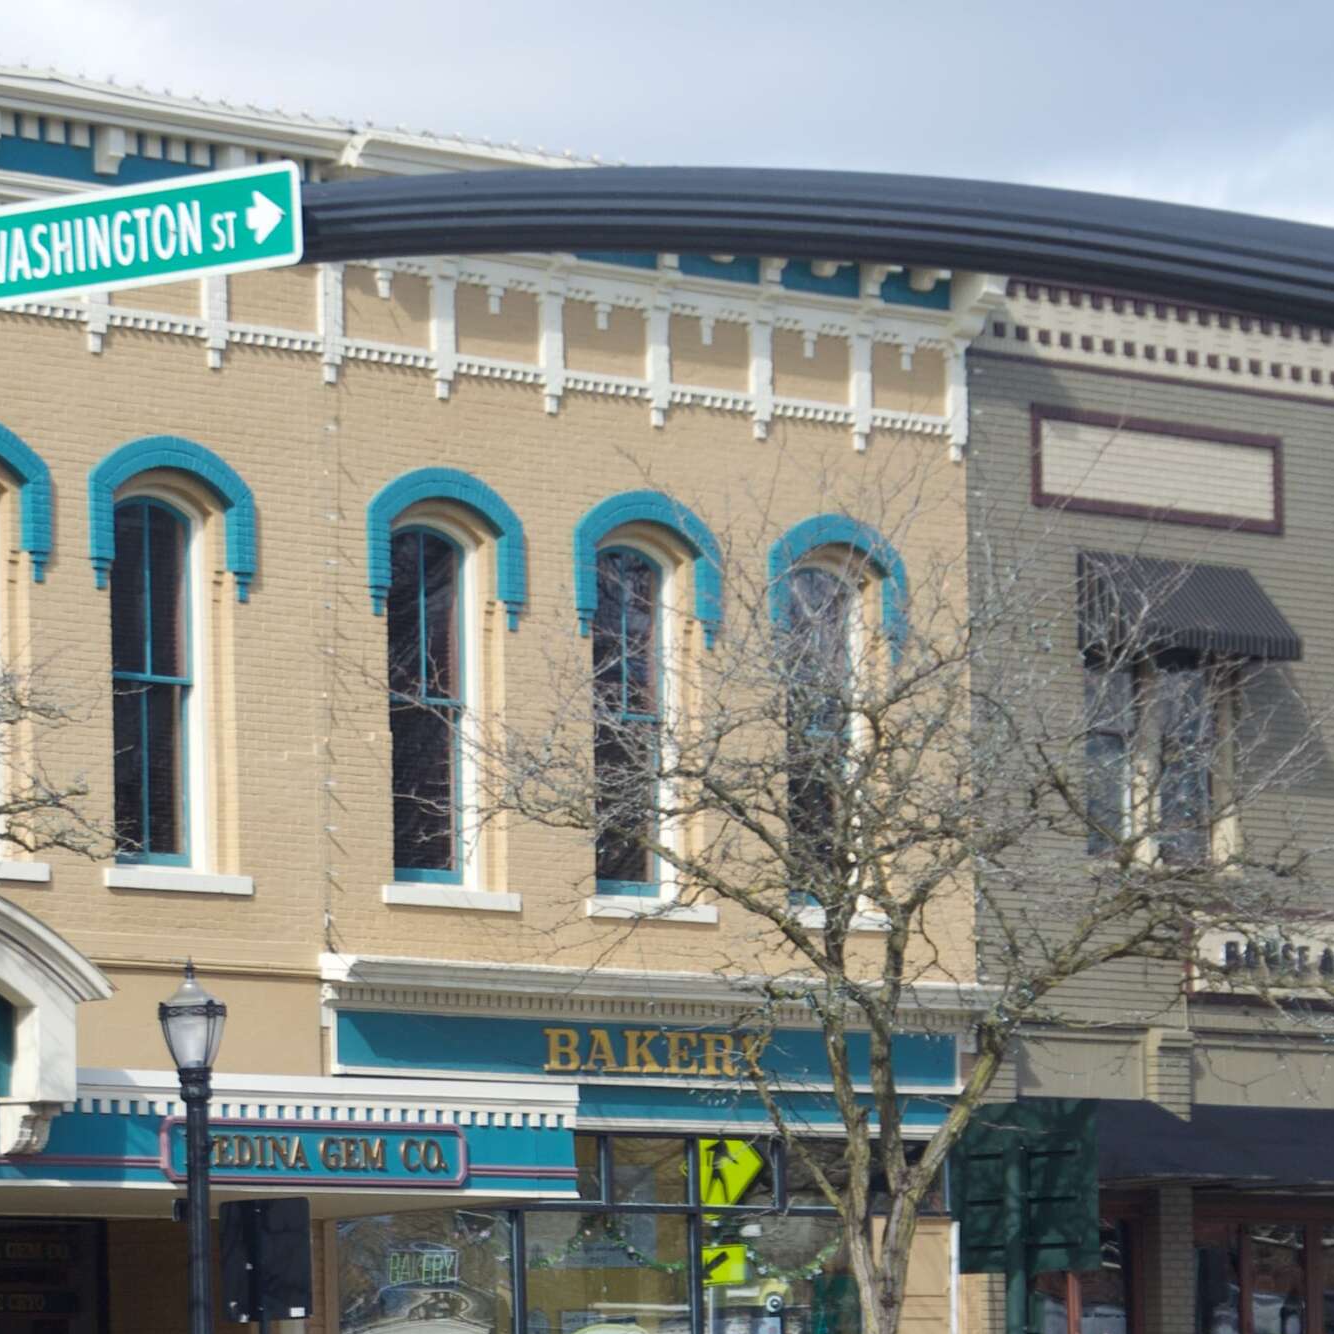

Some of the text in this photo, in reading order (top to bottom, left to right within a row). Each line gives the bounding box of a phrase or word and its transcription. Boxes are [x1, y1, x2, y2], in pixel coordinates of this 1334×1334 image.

[209, 210, 237, 252] ST
[543, 1028, 770, 1077] BAKERY
[184, 1134, 449, 1173] EDINA GEM CO.
[389, 1252, 455, 1285] BAKERY
